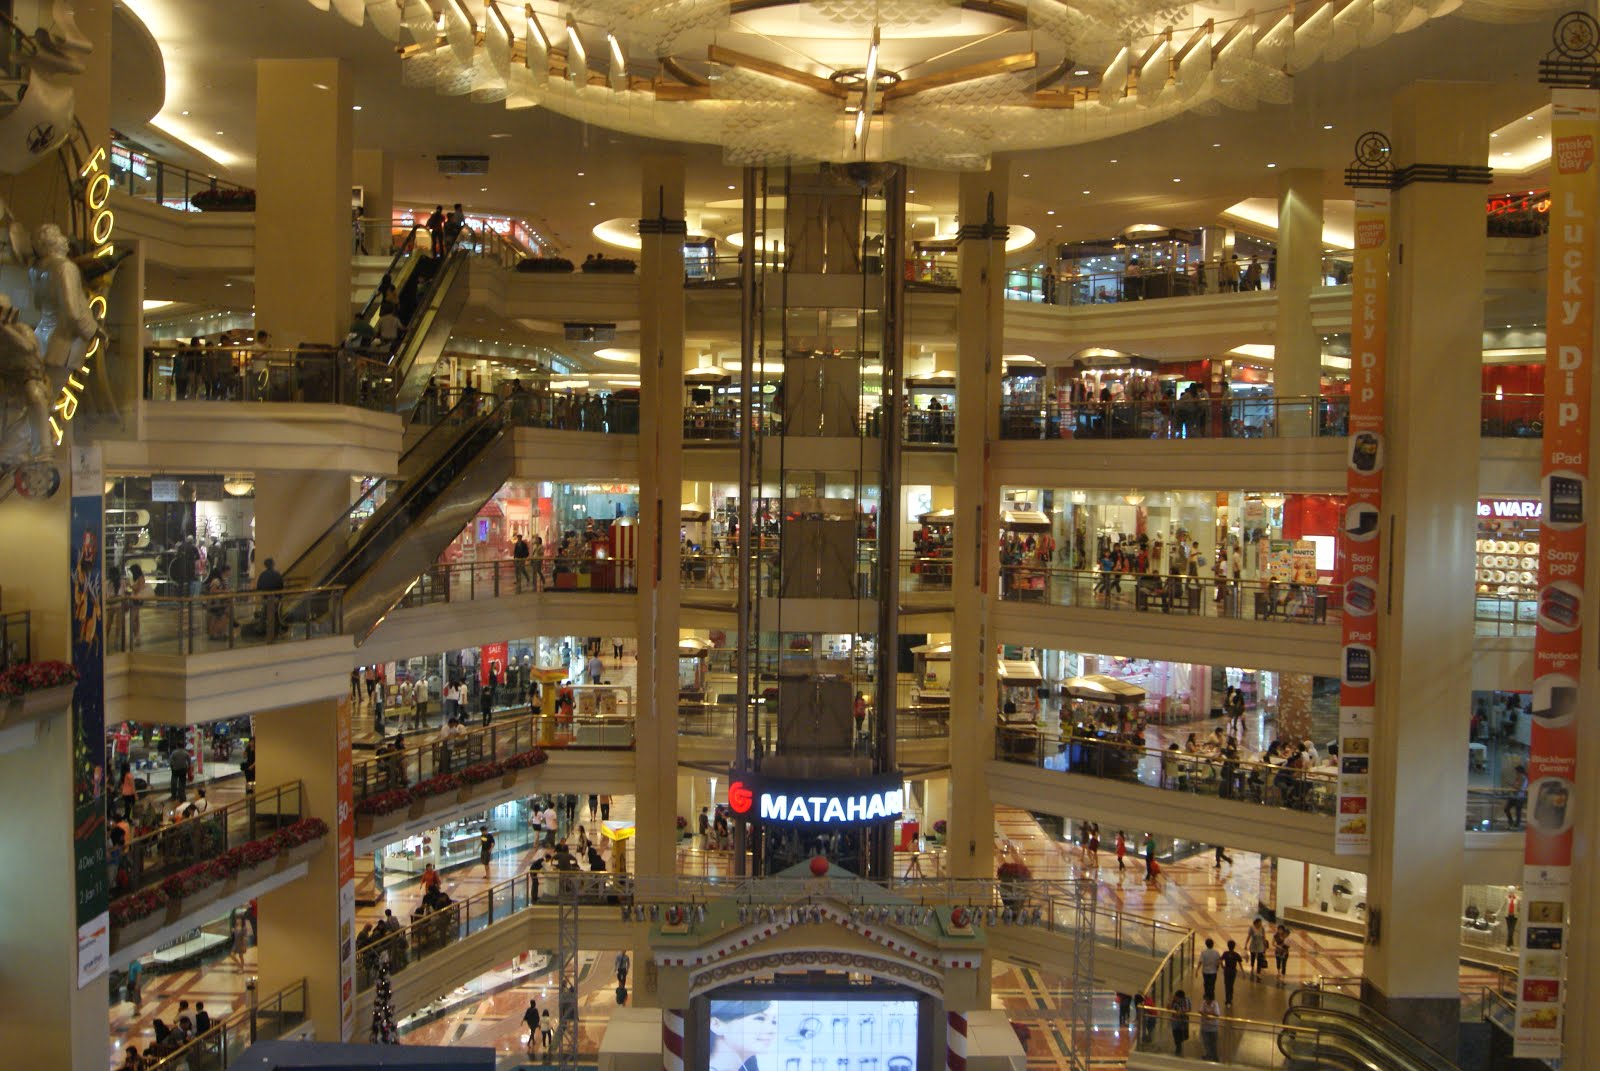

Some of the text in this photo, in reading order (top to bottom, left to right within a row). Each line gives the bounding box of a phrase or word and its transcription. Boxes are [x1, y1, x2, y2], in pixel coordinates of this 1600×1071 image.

[1558, 139, 1592, 149] make
[1559, 159, 1583, 169] day
[1551, 452, 1582, 465] iPad
[1351, 553, 1375, 563] Sony
[1547, 550, 1580, 563] Sony
[1352, 564, 1373, 573] PSP
[1550, 565, 1577, 576] PSP
[1349, 631, 1372, 641] iPad
